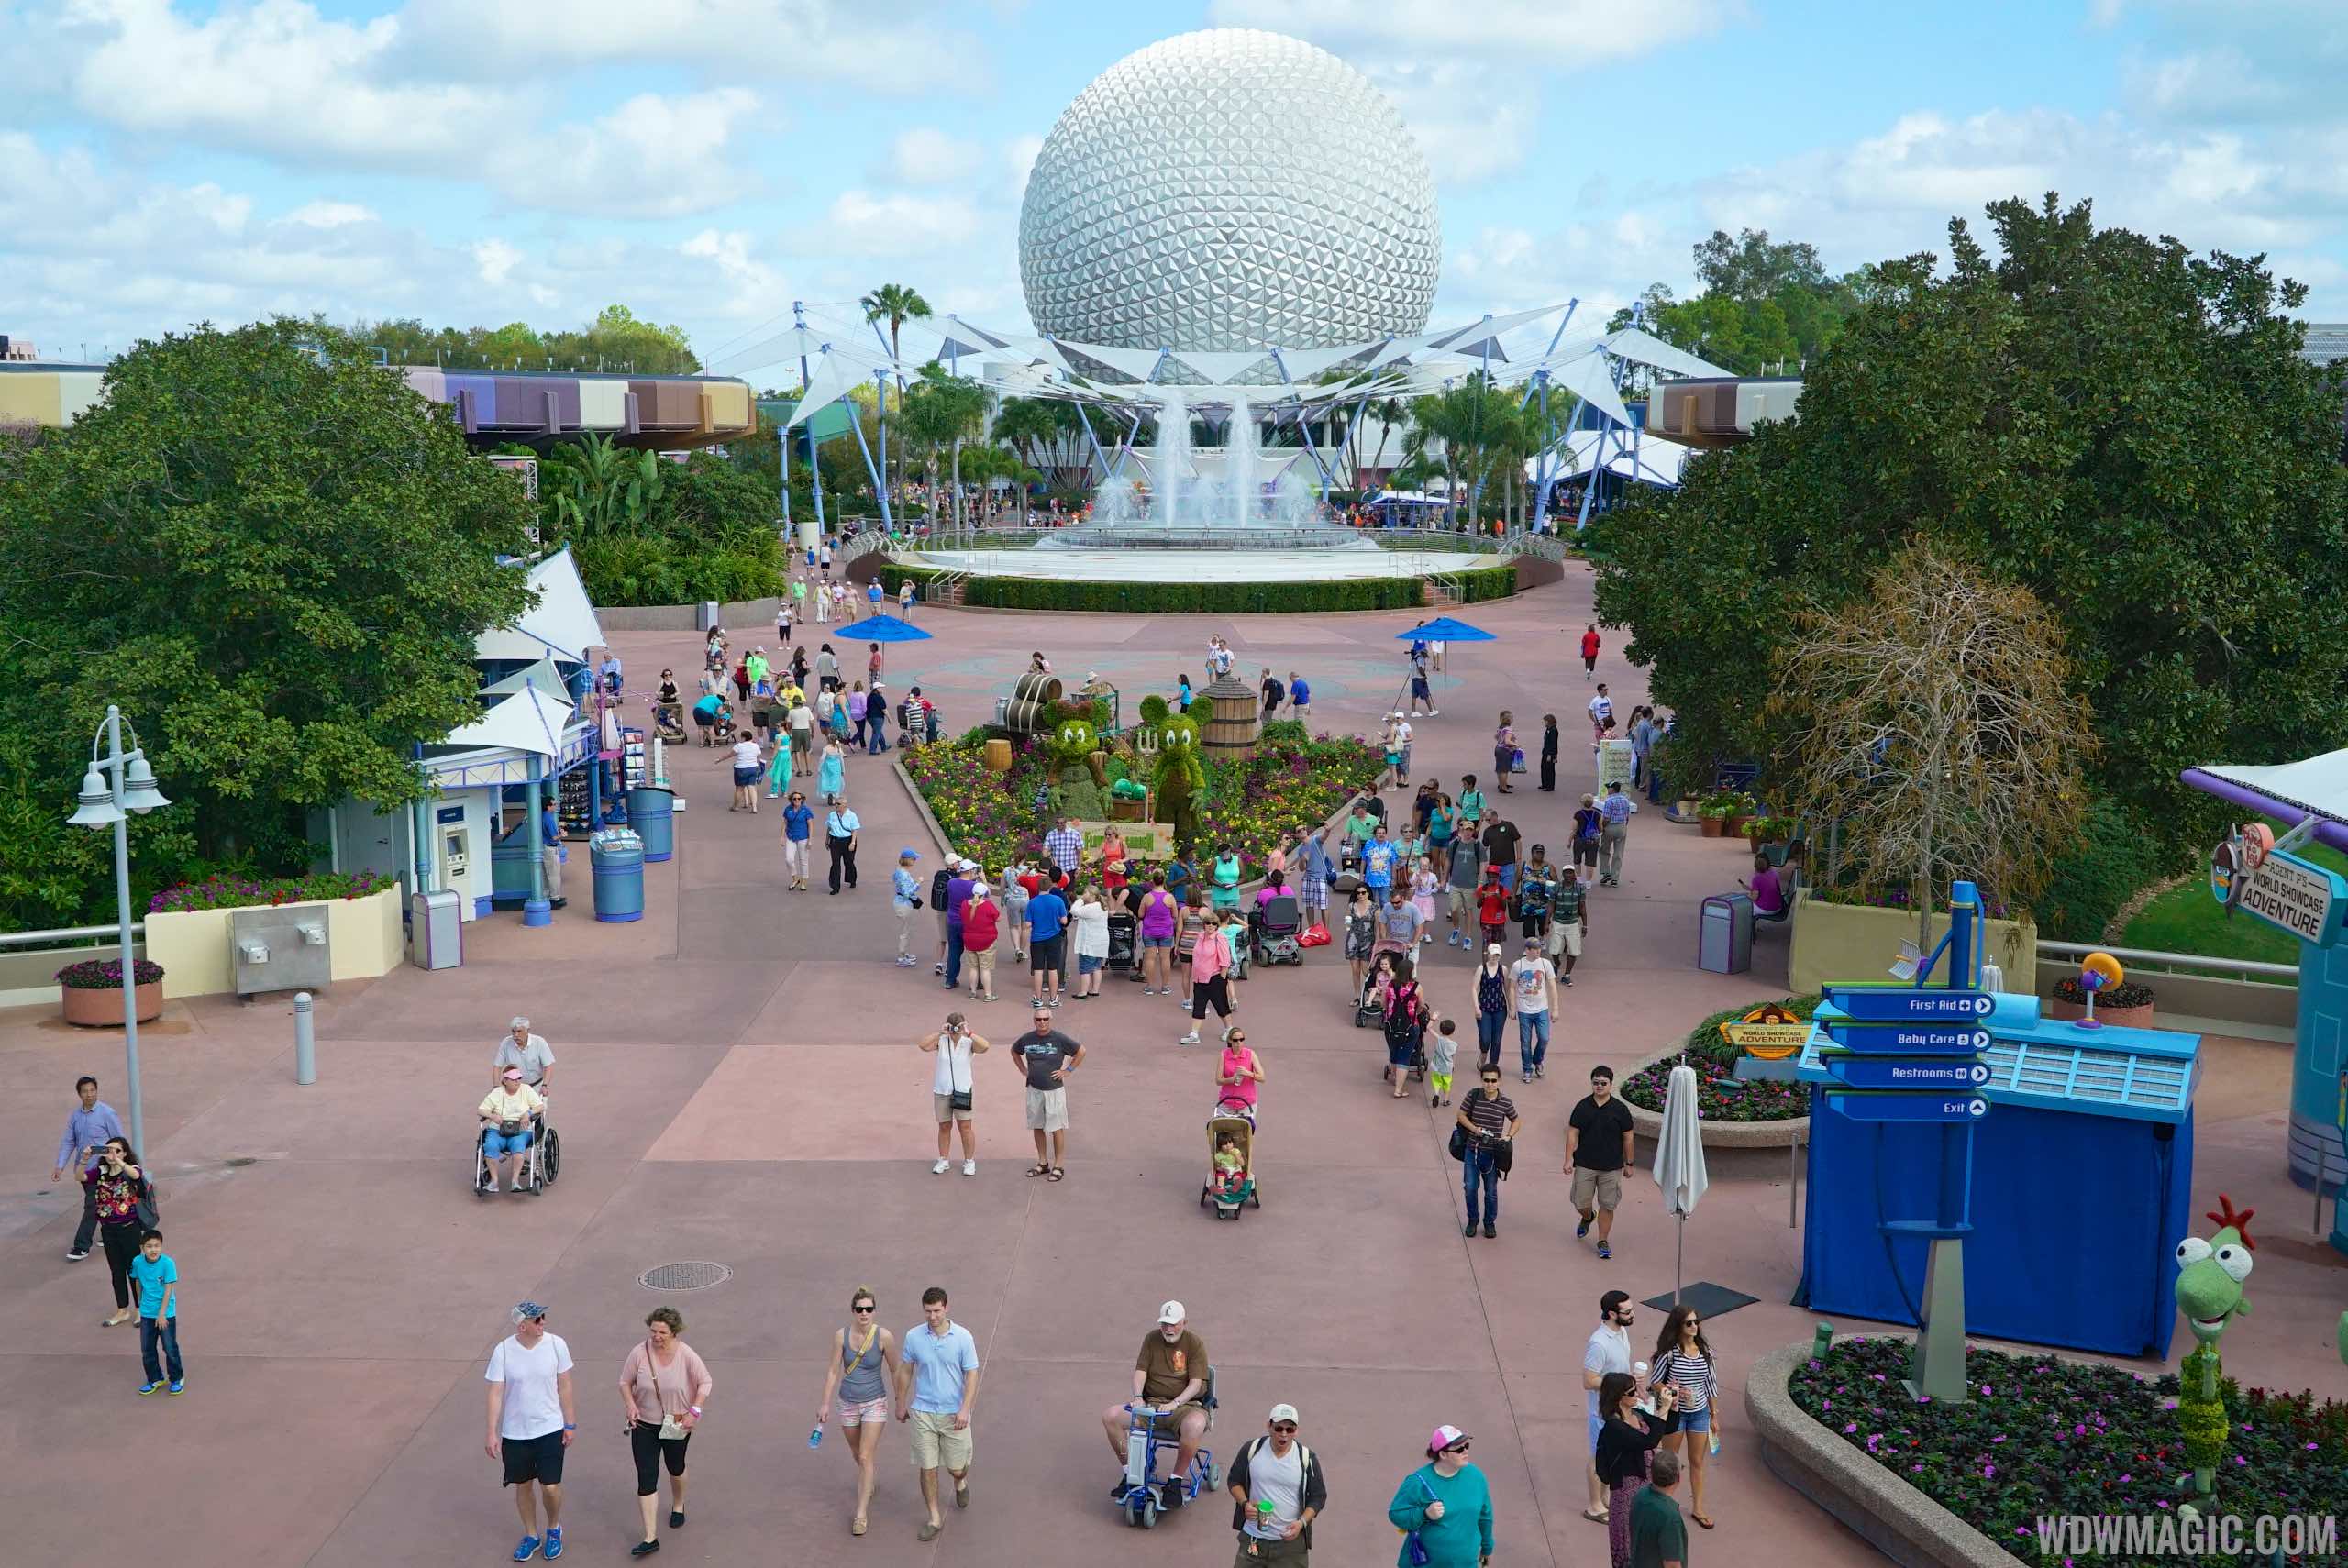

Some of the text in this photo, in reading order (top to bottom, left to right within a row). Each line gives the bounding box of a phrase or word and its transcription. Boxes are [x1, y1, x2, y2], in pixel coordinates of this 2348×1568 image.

[2254, 872, 2324, 915] WORLD SHOWCASE
[2243, 888, 2320, 936] ADVENTURE
[1910, 999, 1956, 1010] First Aid
[1898, 1033, 1955, 1045] Baby Care
[1892, 1067, 1954, 1078] Restrooms
[1944, 1103, 1965, 1113] Exit
